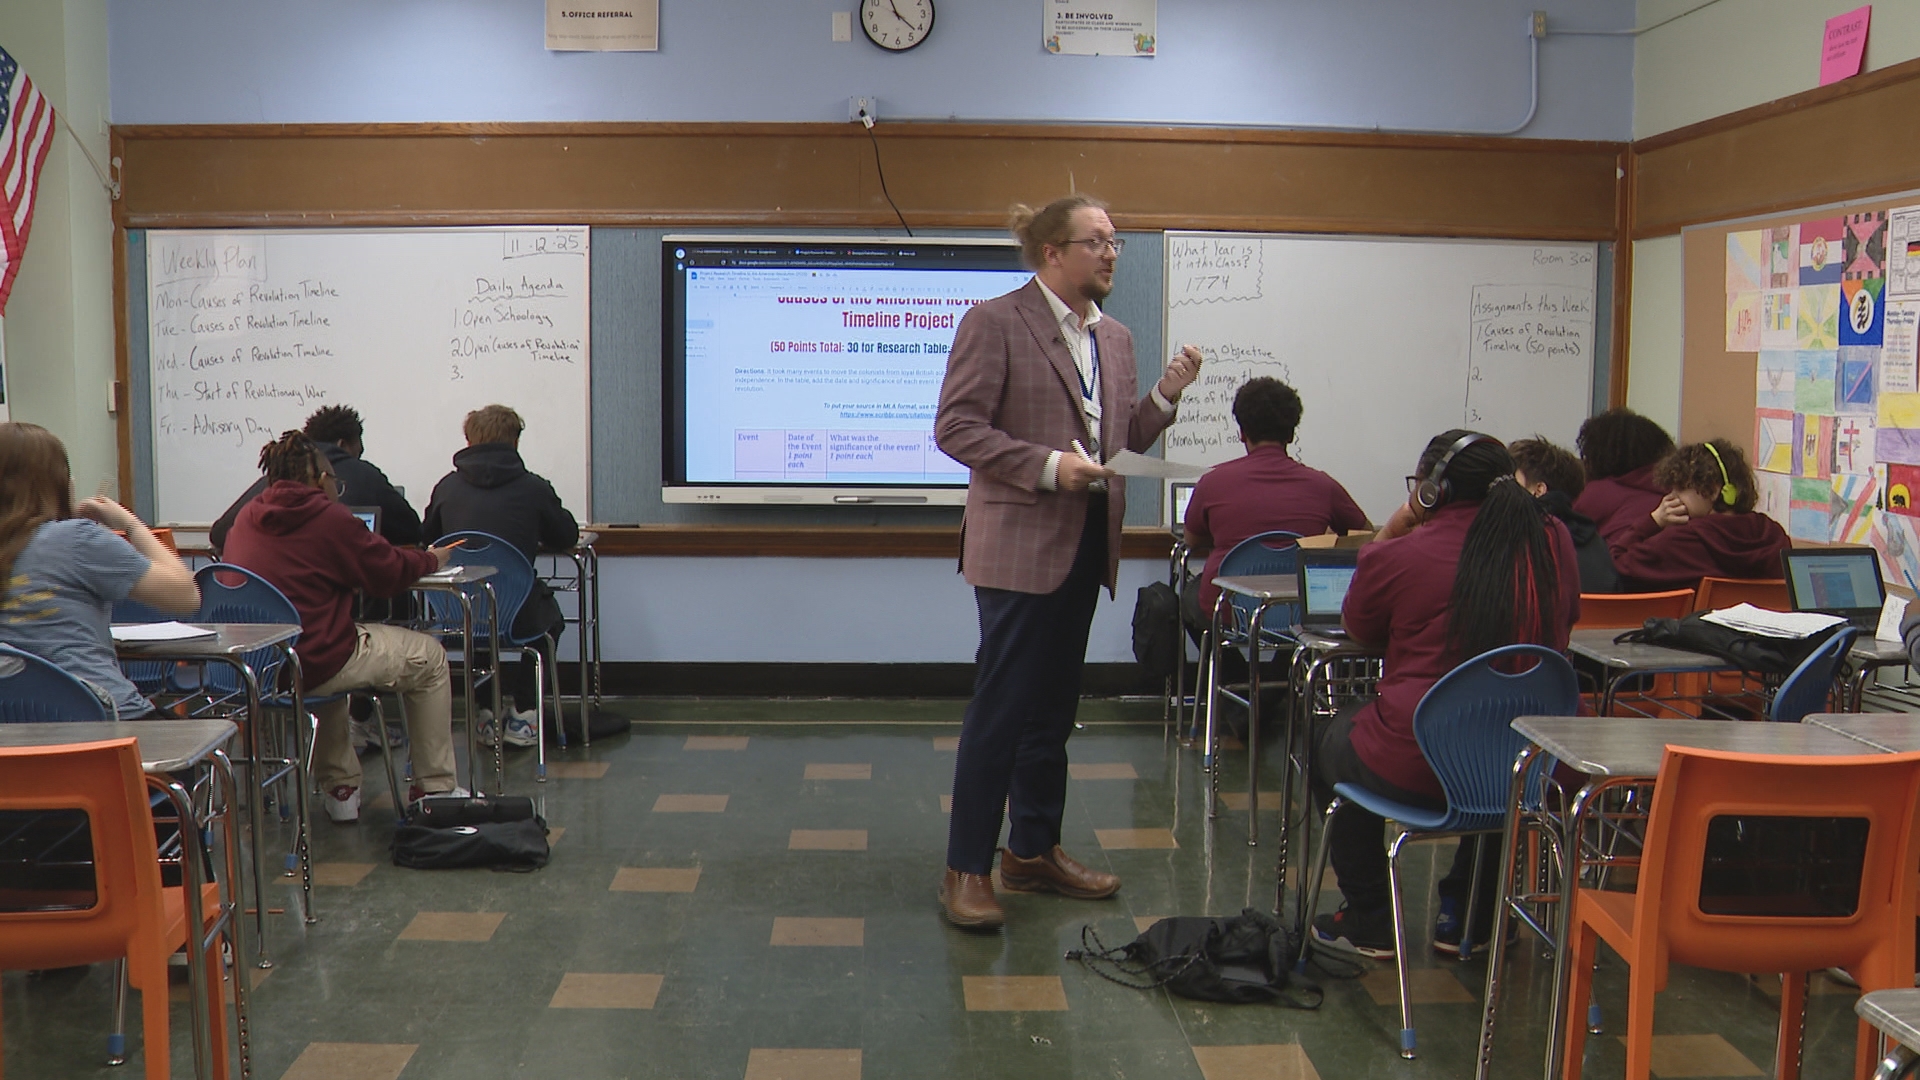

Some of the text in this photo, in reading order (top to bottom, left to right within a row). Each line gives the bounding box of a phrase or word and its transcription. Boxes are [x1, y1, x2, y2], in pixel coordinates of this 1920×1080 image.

[868, 11, 873, 20] 9
[920, 10, 926, 18] 3
[872, 24, 878, 33] 8
[908, 32, 914, 41] 5
[882, 33, 888, 41] 7
[895, 36, 901, 45] 6
[1173, 240, 1253, 258] What Year is
[162, 245, 256, 280] Weekly Plan
[1173, 260, 1181, 270] it
[1216, 255, 1250, 268] Class?
[1532, 249, 1564, 266] Room
[476, 276, 564, 298] Daily Agenda
[1186, 274, 1230, 292] 1774
[190, 284, 226, 310] Causes
[232, 292, 244, 306] of
[250, 283, 300, 304] Revolution
[299, 280, 340, 298] Timeline
[1473, 293, 1590, 318] Assignments this Week
[190, 314, 225, 335] Causes
[228, 316, 241, 331] of
[247, 315, 288, 329] Revolution
[289, 310, 330, 327] Timeline
[463, 310, 492, 328] Open
[494, 304, 553, 327] Schoology
[842, 311, 954, 330] Timeline Project
[1484, 323, 1514, 337] Causes
[1519, 322, 1531, 334] of
[1537, 323, 1580, 338] Revolution
[464, 336, 489, 360] Open
[520, 338, 531, 350] of
[770, 341, 950, 354] (50 Points Total: 30 for Research Table:
[1221, 344, 1276, 360] Objective
[1483, 336, 1581, 358] Timeline (50 points)
[156, 344, 334, 372] Wed Causes of Revolution Timeline
[530, 350, 575, 364] Timeline
[451, 365, 464, 380] 3.
[1205, 372, 1238, 389] arrange
[1471, 366, 1482, 381] 2.
[158, 380, 327, 406] Thu Start of Revolutionary War
[1205, 391, 1216, 404] of
[1470, 409, 1481, 422] 3.
[192, 414, 244, 447] Advisory
[245, 418, 275, 440] Day
[830, 443, 873, 452] significance
[794, 452, 812, 461] point
[835, 452, 854, 461] point
